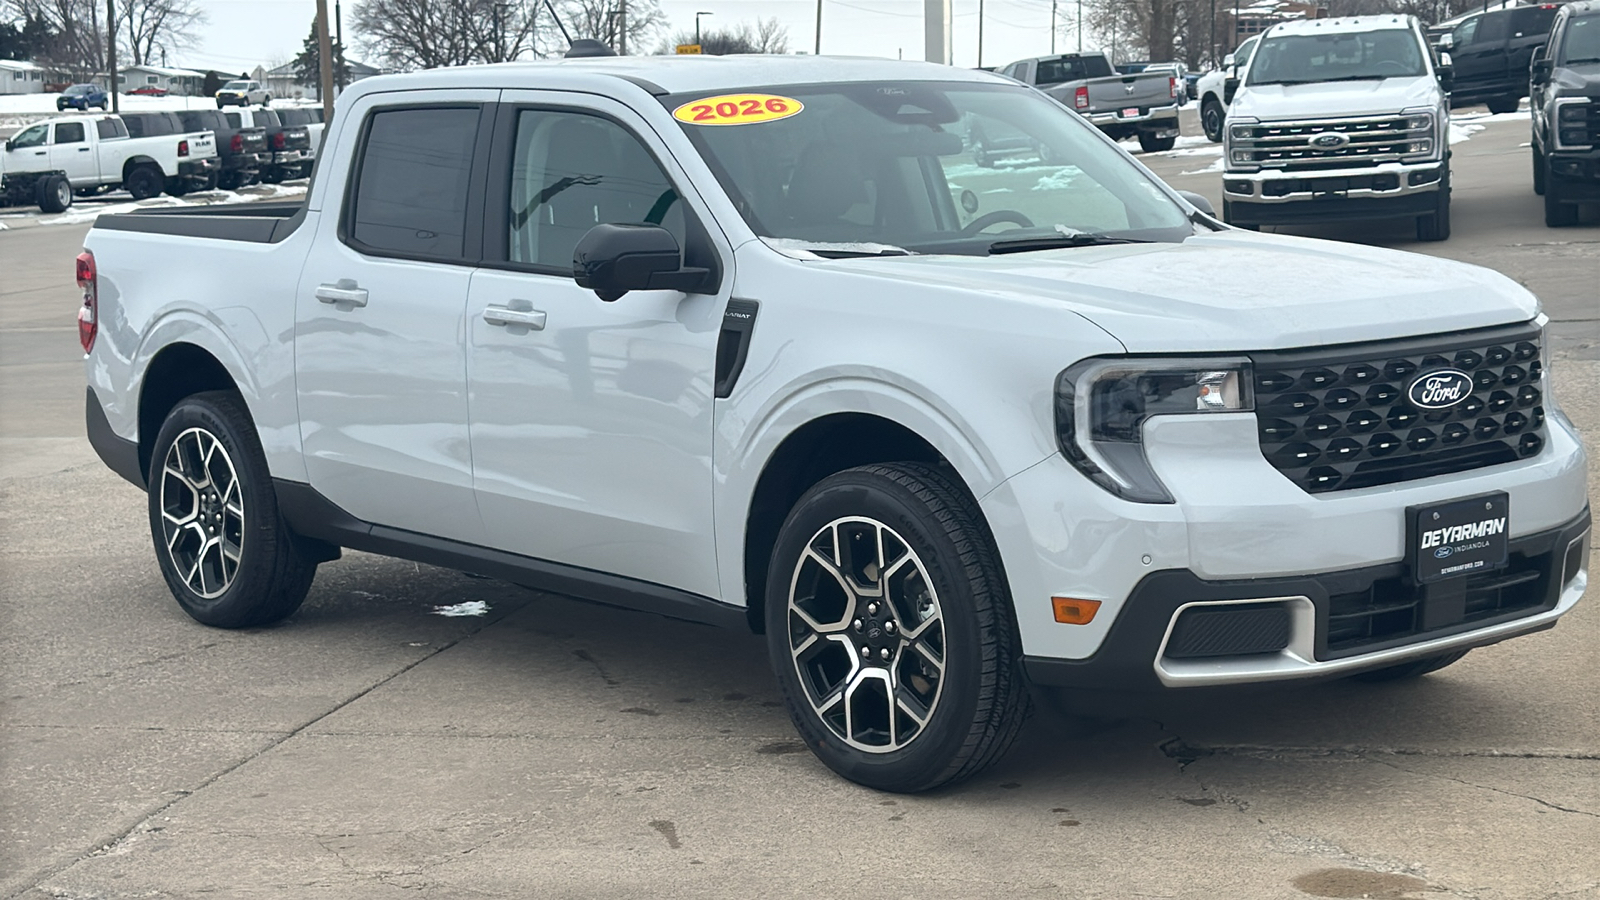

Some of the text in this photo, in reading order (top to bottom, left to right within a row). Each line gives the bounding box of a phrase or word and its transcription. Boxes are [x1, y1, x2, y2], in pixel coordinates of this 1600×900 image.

[691, 98, 789, 121] 2026
[724, 311, 751, 319] LARIAT
[1421, 376, 1462, 404] Ford
[1421, 517, 1506, 549] DEYARMAN
[1454, 540, 1490, 553] INDIANOLA
